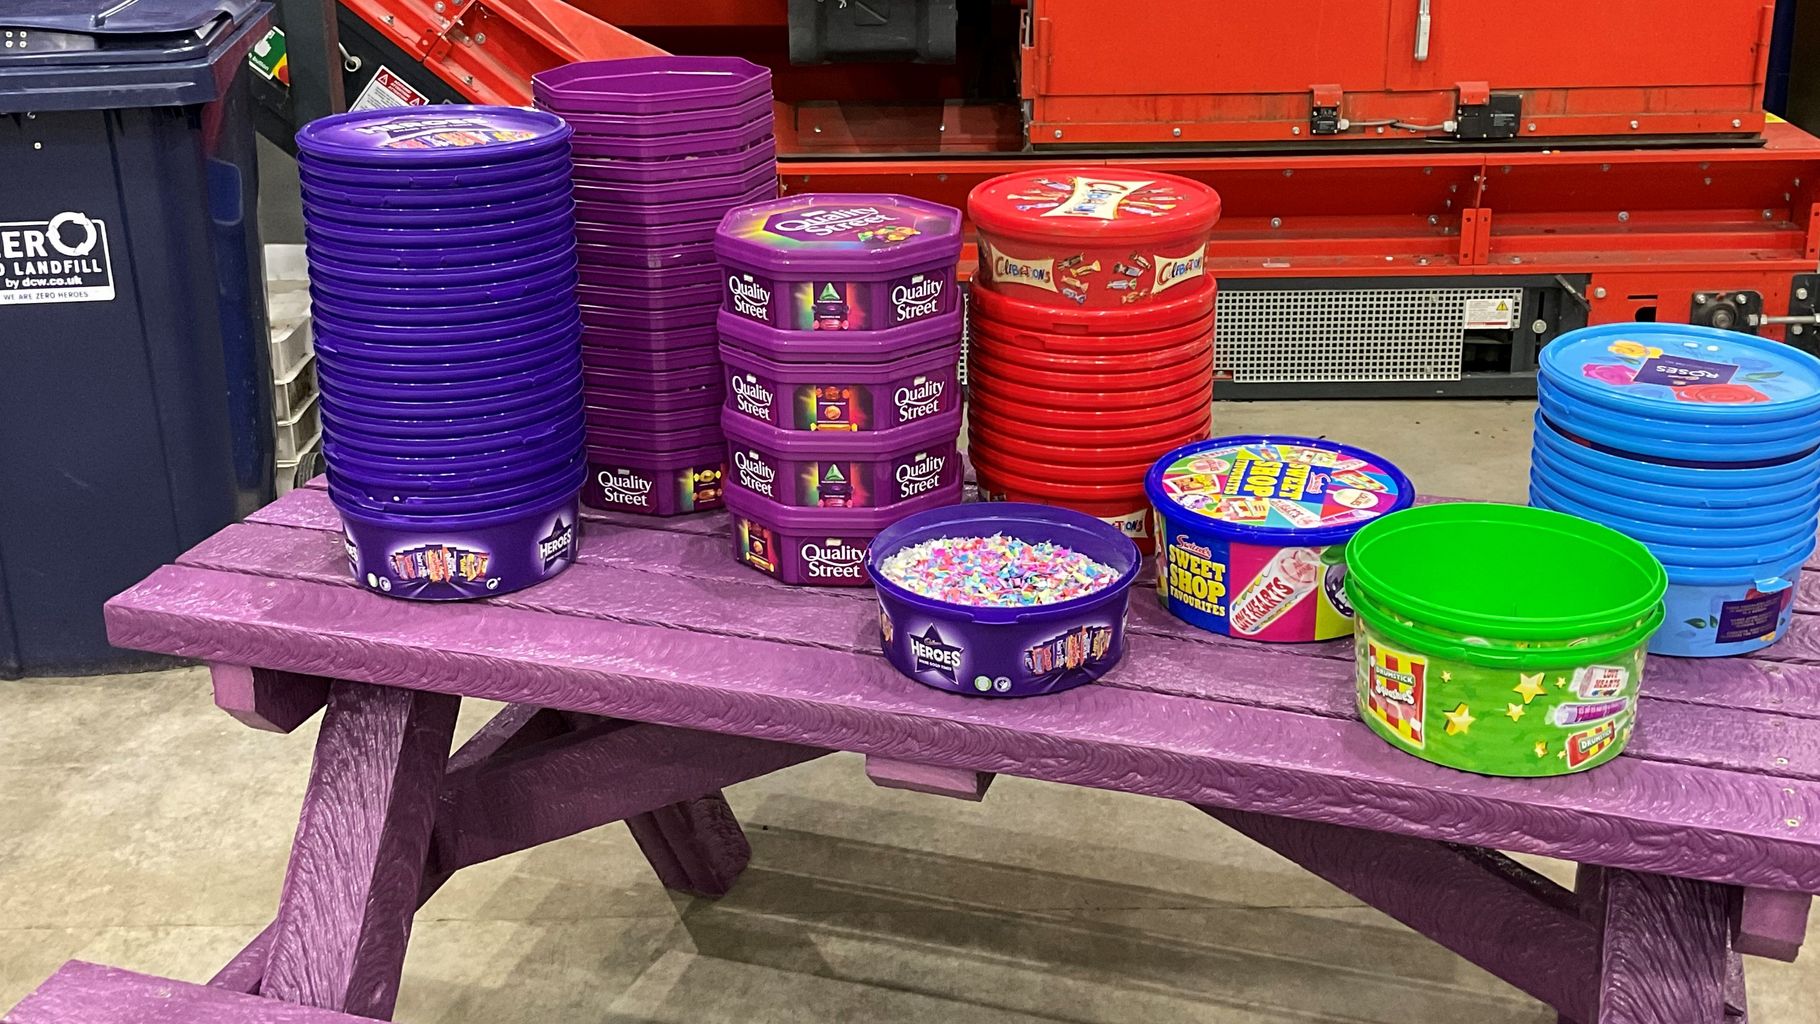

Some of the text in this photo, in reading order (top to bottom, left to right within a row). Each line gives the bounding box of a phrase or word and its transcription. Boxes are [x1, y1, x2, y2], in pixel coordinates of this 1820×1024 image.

[775, 206, 882, 232] Quality
[805, 214, 897, 236] Street
[13, 259, 102, 275] LANDFILL
[5, 275, 82, 289] by dcw.co.uk
[729, 275, 771, 306] Quality
[892, 279, 943, 305] Quality
[734, 298, 768, 321] Street
[897, 299, 938, 321] Street
[1656, 365, 1719, 379] ROSES
[732, 375, 773, 407] Quality
[895, 381, 945, 407] Quality
[738, 396, 771, 421] Street
[899, 402, 939, 422] Street
[735, 451, 775, 483] Quality
[896, 456, 945, 483] Quality
[1243, 460, 1283, 497] SHOP
[598, 471, 652, 495] Quality
[740, 473, 773, 498] Street
[900, 478, 940, 498] Street
[1279, 463, 1311, 500] SWEET
[604, 487, 649, 507] Street
[540, 528, 571, 559] HEROES
[801, 543, 868, 567] Quality
[809, 562, 862, 578] Street
[1169, 544, 1226, 582] SWEET
[1169, 563, 1226, 604] SHOP
[1170, 585, 1226, 617] FAVOURITES
[1246, 576, 1294, 619] HEARTS
[911, 638, 961, 667] HEROES
[1375, 665, 1414, 685] DRUMSTICK
